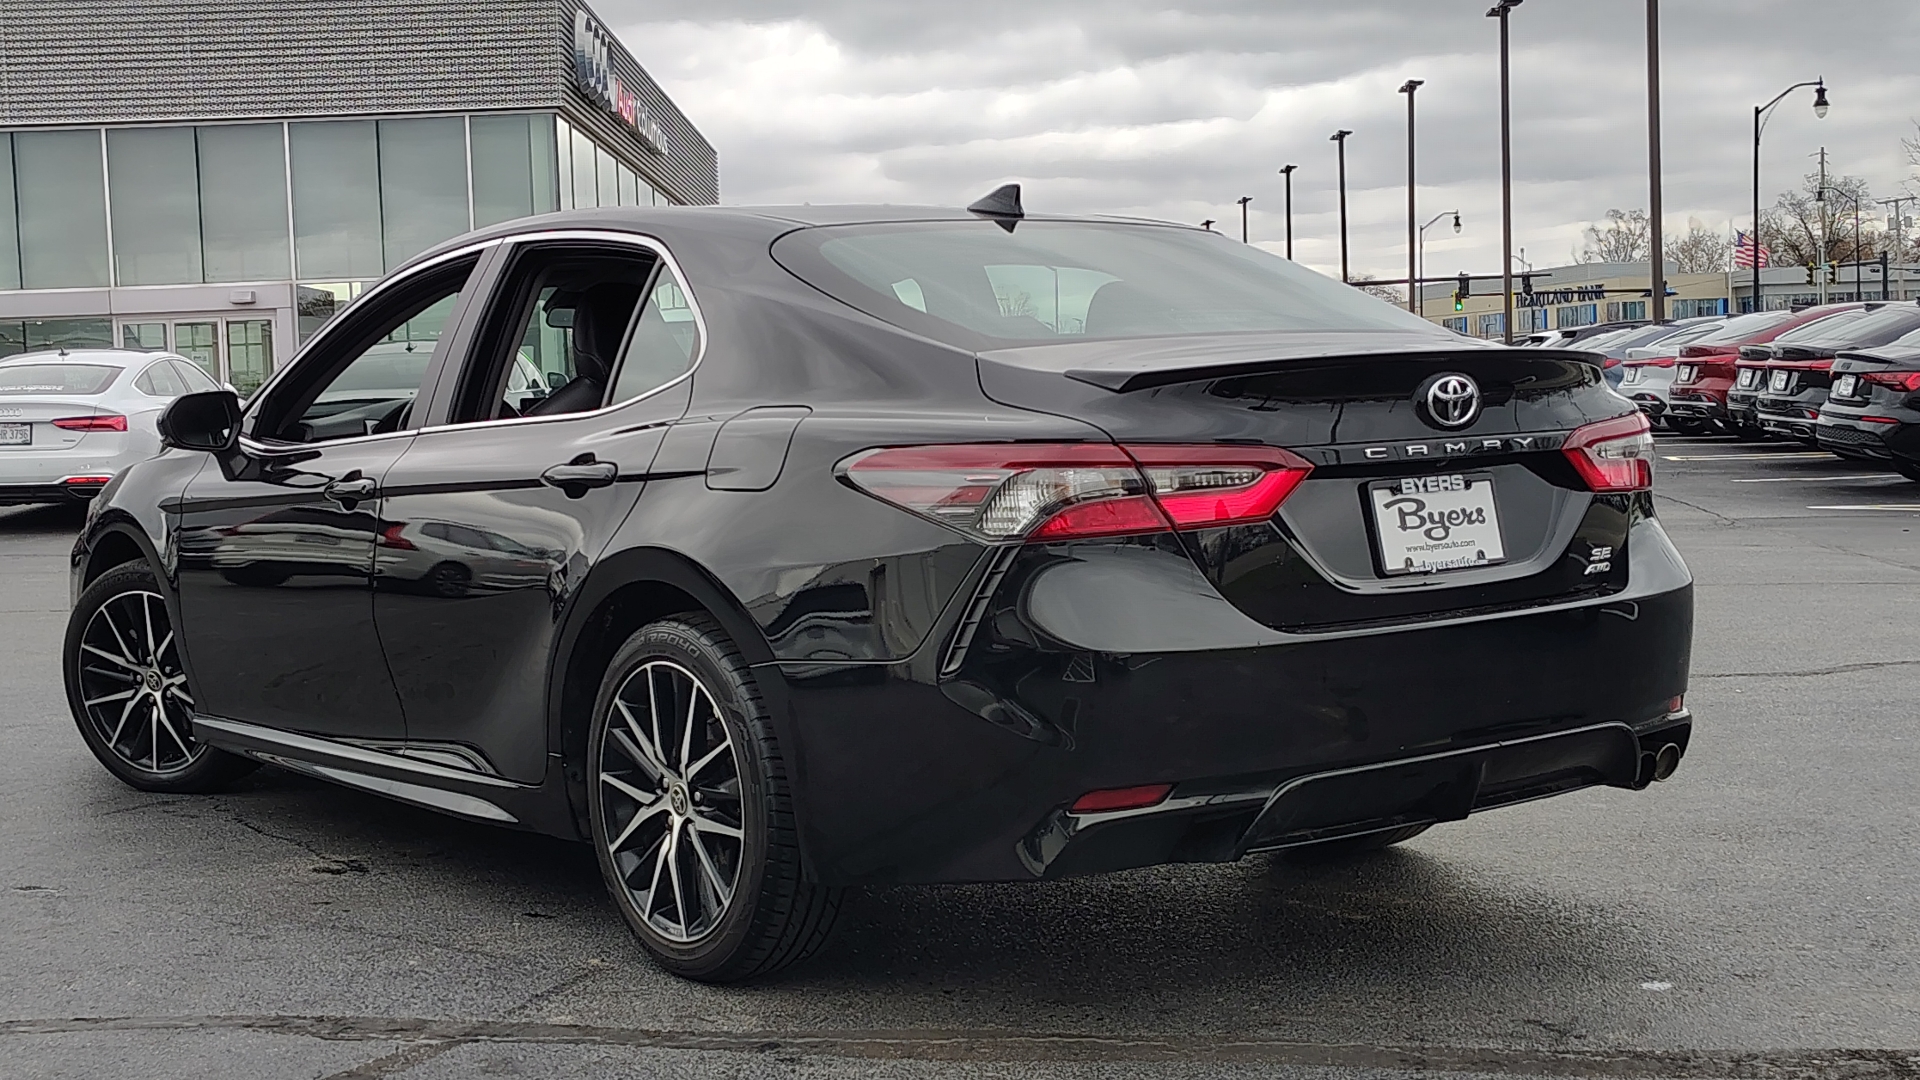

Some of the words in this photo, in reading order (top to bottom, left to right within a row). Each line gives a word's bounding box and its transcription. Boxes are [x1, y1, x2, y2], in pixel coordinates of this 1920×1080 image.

[616, 80, 635, 127] Audi
[1577, 283, 1606, 302] BANK
[1364, 436, 1534, 459] CAMRY
[1400, 474, 1465, 494] BYERS
[1382, 497, 1487, 542] Byers
[1405, 540, 1476, 553] www.byersauto.com
[1589, 546, 1612, 561] SE
